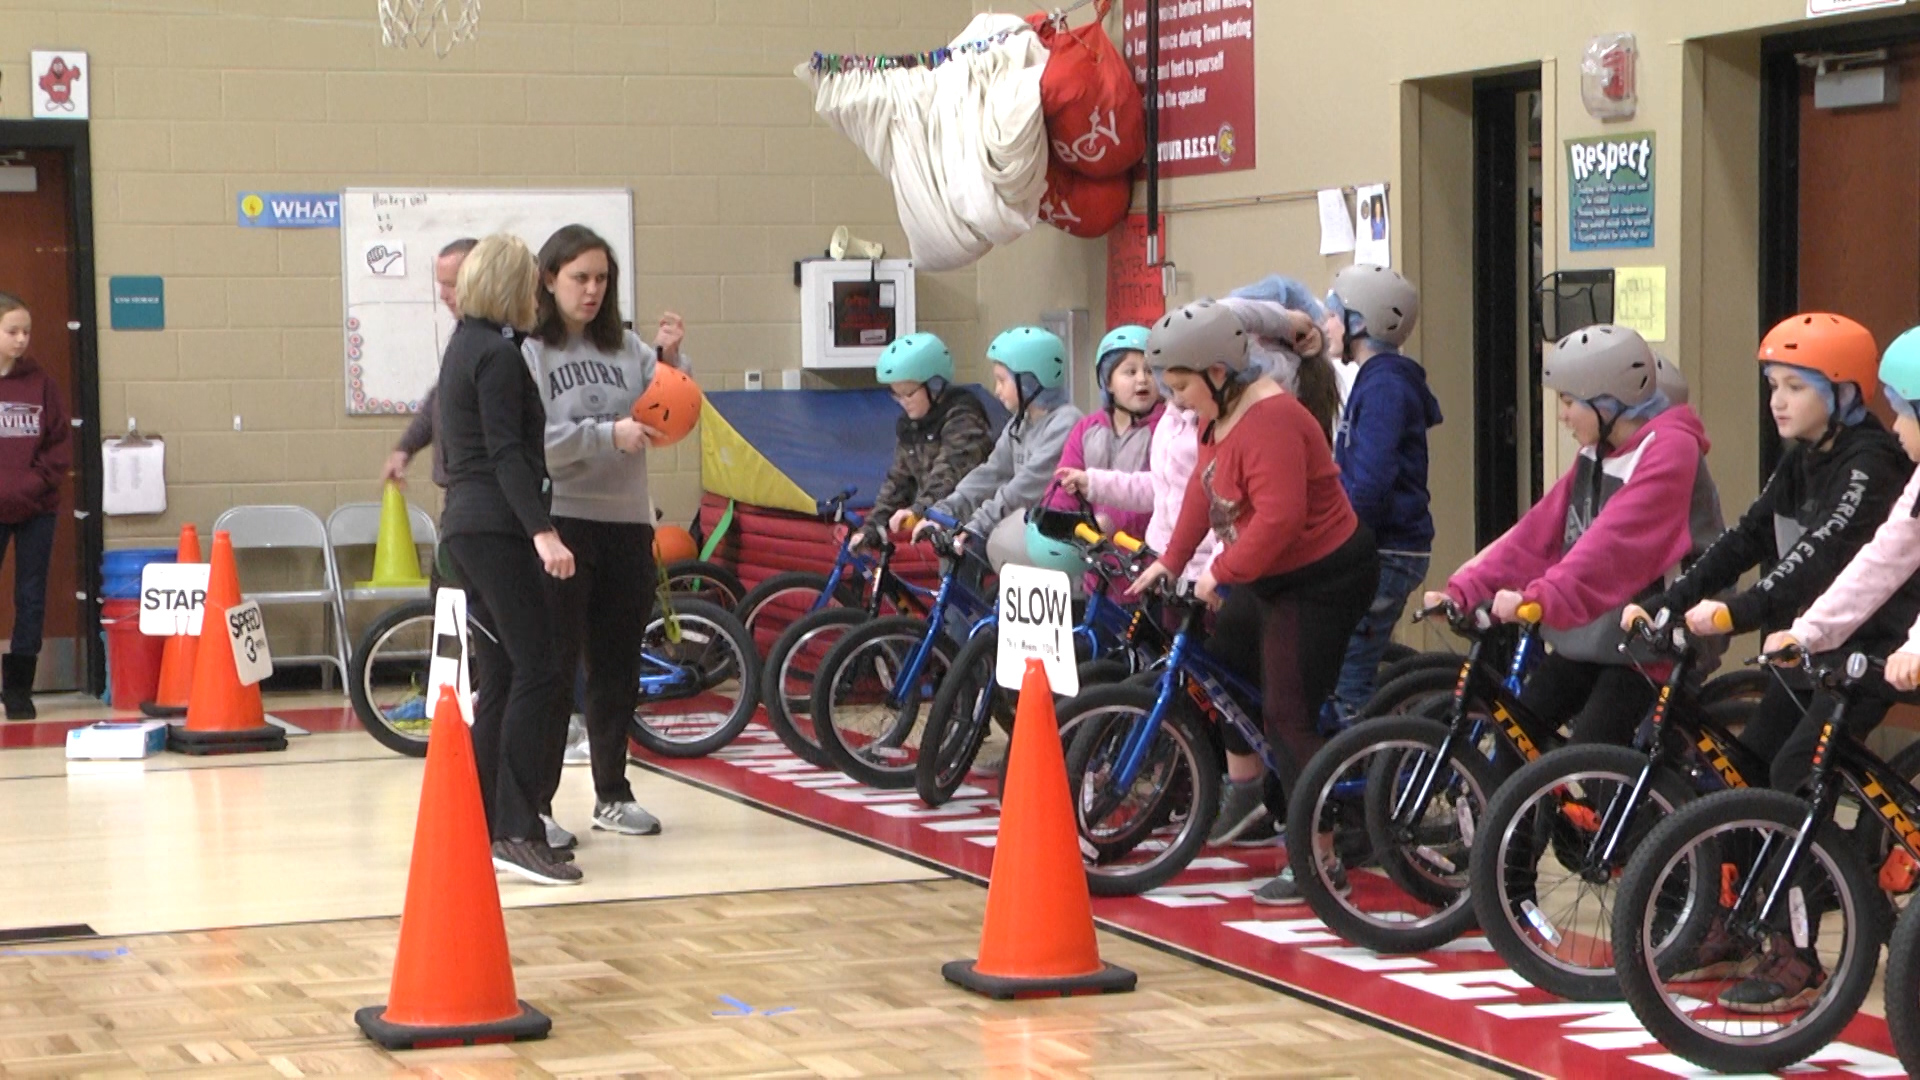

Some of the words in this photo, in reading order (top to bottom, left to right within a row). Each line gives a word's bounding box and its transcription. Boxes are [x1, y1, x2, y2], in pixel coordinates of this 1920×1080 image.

[1179, 27, 1202, 48] during
[1203, 23, 1221, 43] Town
[1222, 17, 1252, 39] Meeting
[1170, 57, 1185, 78] feet
[1186, 57, 1194, 76] to
[1195, 50, 1224, 78] yourself
[1165, 89, 1177, 108] the
[1178, 85, 1207, 109] speaker
[1157, 139, 1182, 162] YOUR
[1570, 138, 1650, 180] Respect
[271, 201, 338, 218] WHAT
[548, 359, 629, 401] AUBURN
[1756, 541, 1816, 592] EAGLE
[1005, 586, 1068, 627] SLOW
[244, 635, 257, 663] 3
